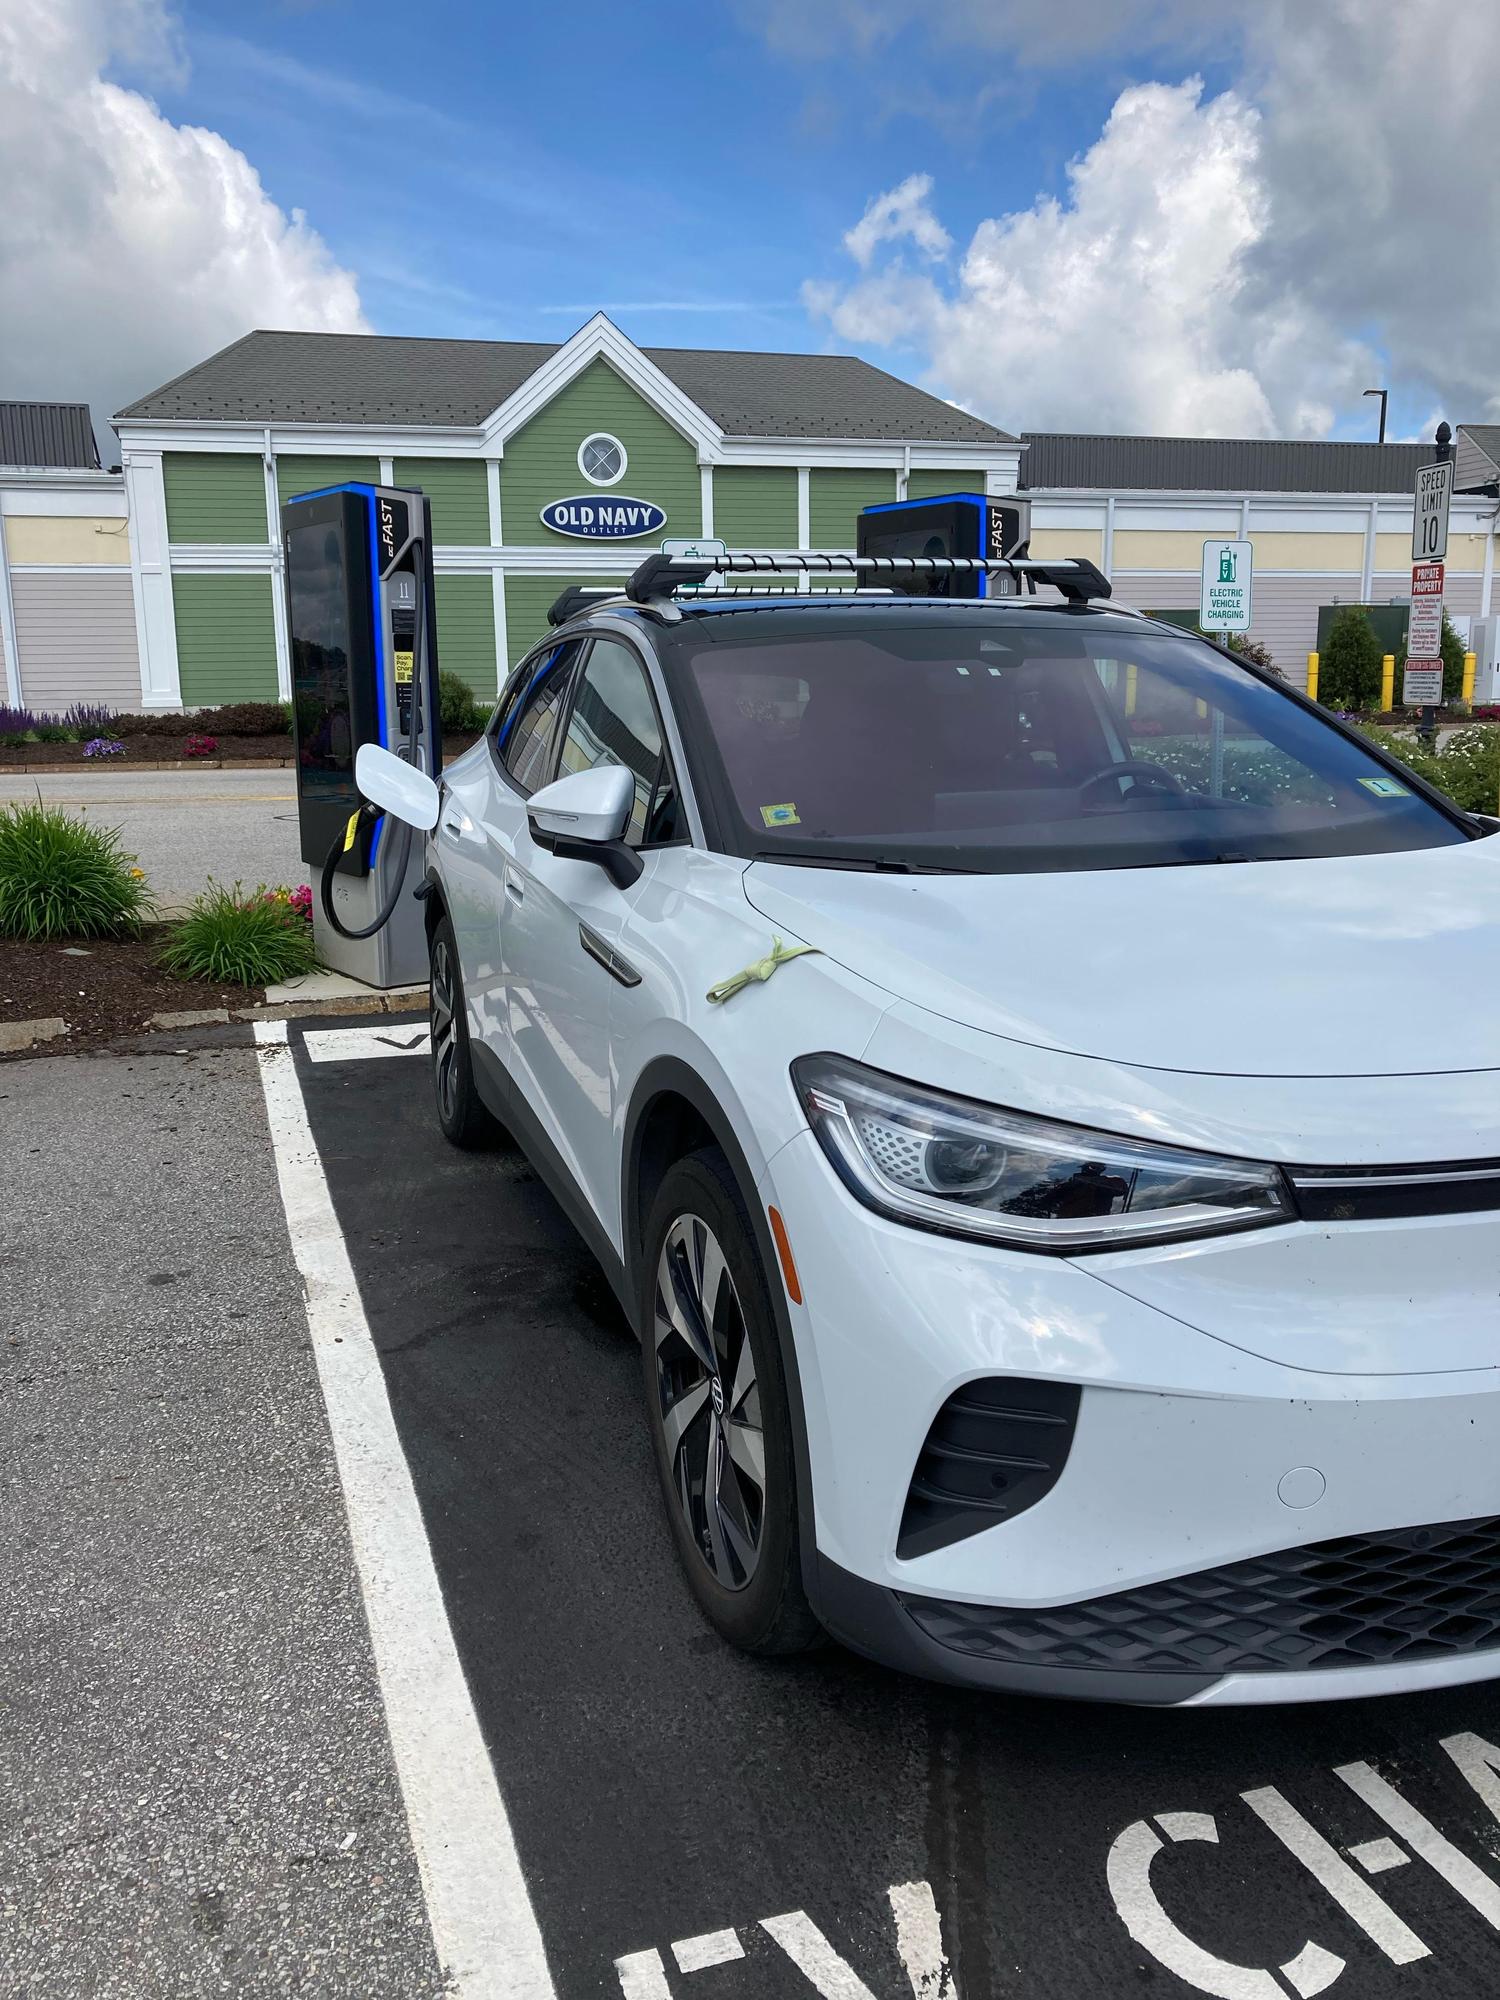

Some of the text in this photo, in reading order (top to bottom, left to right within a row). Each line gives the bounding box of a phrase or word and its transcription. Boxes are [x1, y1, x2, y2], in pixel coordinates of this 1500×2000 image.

[1421, 469, 1446, 492] SPEED
[1422, 491, 1444, 513] LIMIT
[554, 506, 653, 526] OLD NAVY
[582, 526, 627, 534] OUTLET
[1422, 515, 1439, 554] 10
[1416, 567, 1440, 581] PRIVATE
[399, 582, 409, 599] 11
[1000, 579, 1008, 594] 10
[1209, 588, 1243, 597] ELECTRIC
[1413, 580, 1442, 593] PROPERTY
[1211, 599, 1241, 608] VEHICLE
[1207, 610, 1244, 619] CHARGING
